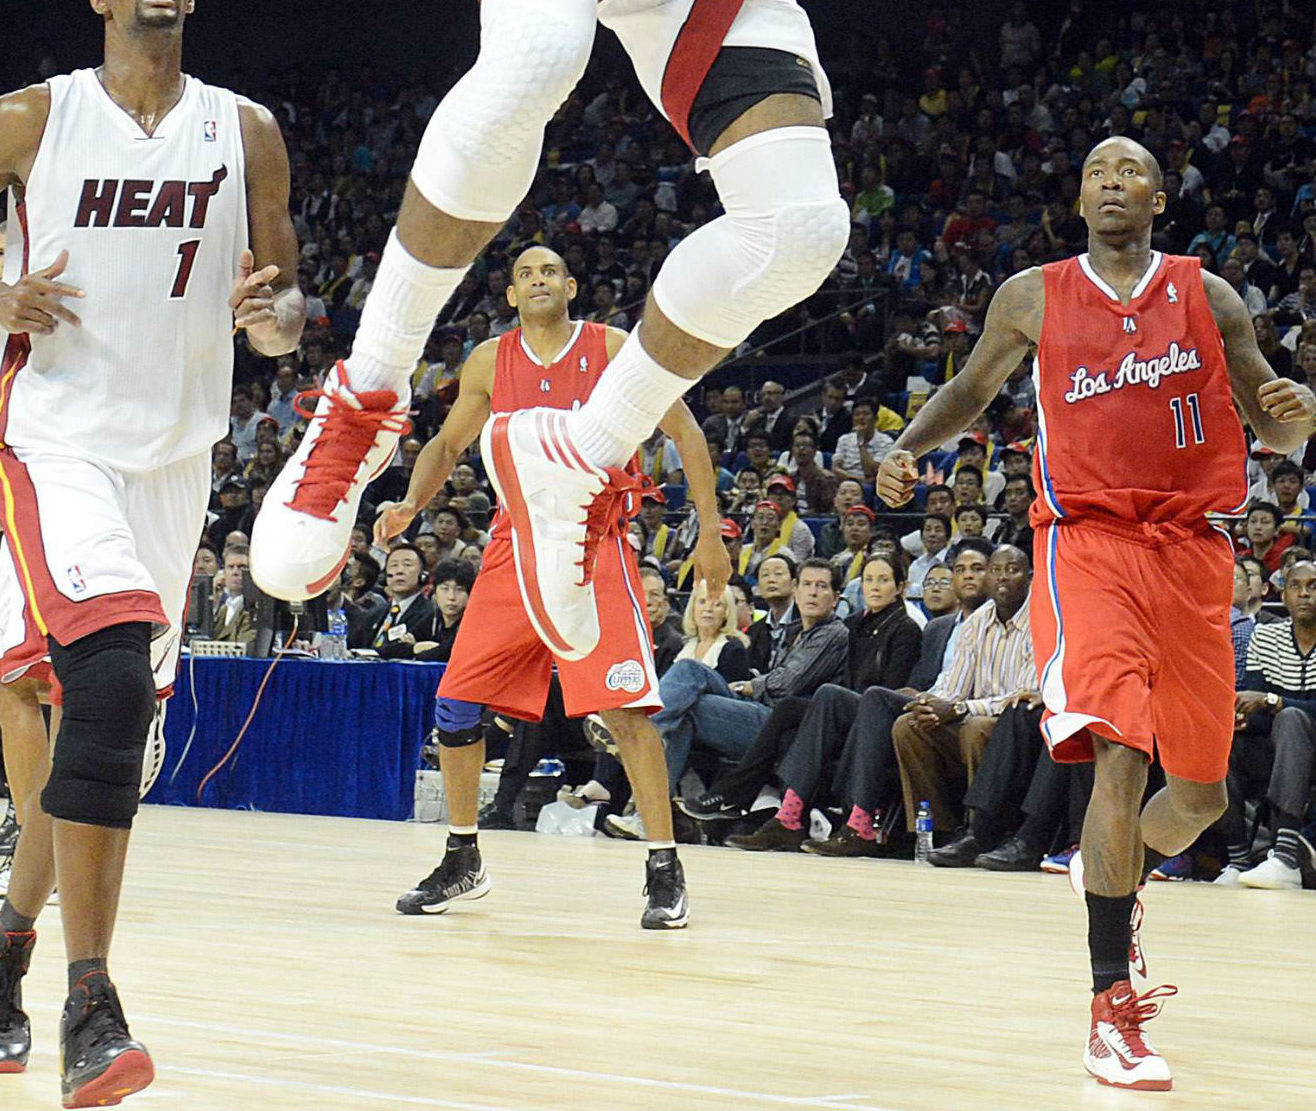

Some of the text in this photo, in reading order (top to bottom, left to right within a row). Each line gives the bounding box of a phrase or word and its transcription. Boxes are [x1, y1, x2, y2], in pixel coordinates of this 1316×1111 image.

[73, 163, 228, 229] HEAT
[170, 239, 202, 298] 1
[1065, 342, 1202, 403] Los Angeles
[1169, 393, 1206, 449] 11
